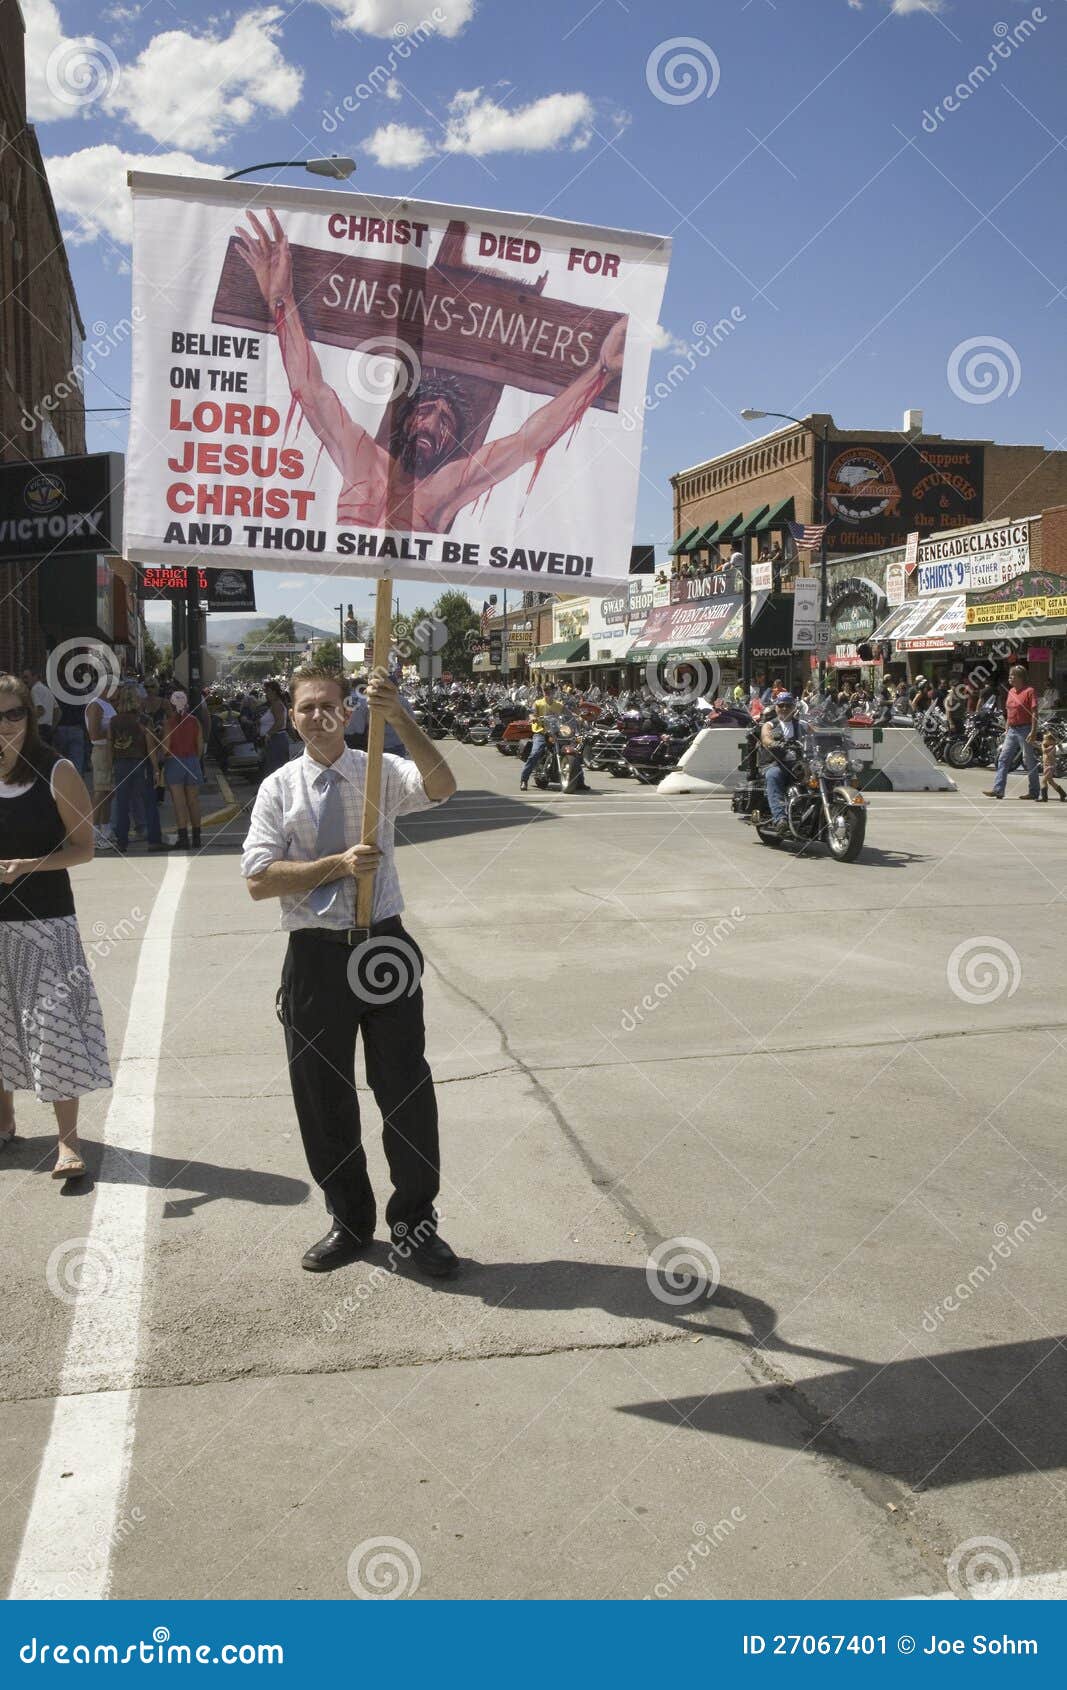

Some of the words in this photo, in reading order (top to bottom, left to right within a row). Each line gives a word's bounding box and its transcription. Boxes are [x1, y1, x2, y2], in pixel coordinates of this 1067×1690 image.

[328, 213, 427, 248] CHRIST
[478, 231, 541, 265] DIED
[567, 247, 621, 278] FOR
[322, 273, 594, 367] SIN-SINS-SINNERS
[171, 331, 260, 360] BELIEVE
[169, 365, 202, 391] ON
[206, 368, 248, 394] THE
[168, 398, 280, 438] LORD
[167, 442, 305, 480] JESUS
[920, 451, 971, 467] Support
[911, 471, 977, 501] STURGIS
[165, 482, 316, 521] CHRIST
[915, 513, 934, 526] the
[162, 521, 233, 547] AND
[243, 525, 327, 553] THOU
[336, 531, 433, 561] SHALT
[441, 541, 479, 567] BE
[488, 546, 594, 578] SAVED!
[840, 531, 887, 547] Officially
[144, 578, 208, 589] ENFORD
[145, 569, 206, 579] STRICTY
[603, 599, 625, 615] SWAP
[630, 593, 653, 610] SHOP
[818, 632, 829, 641] 15
